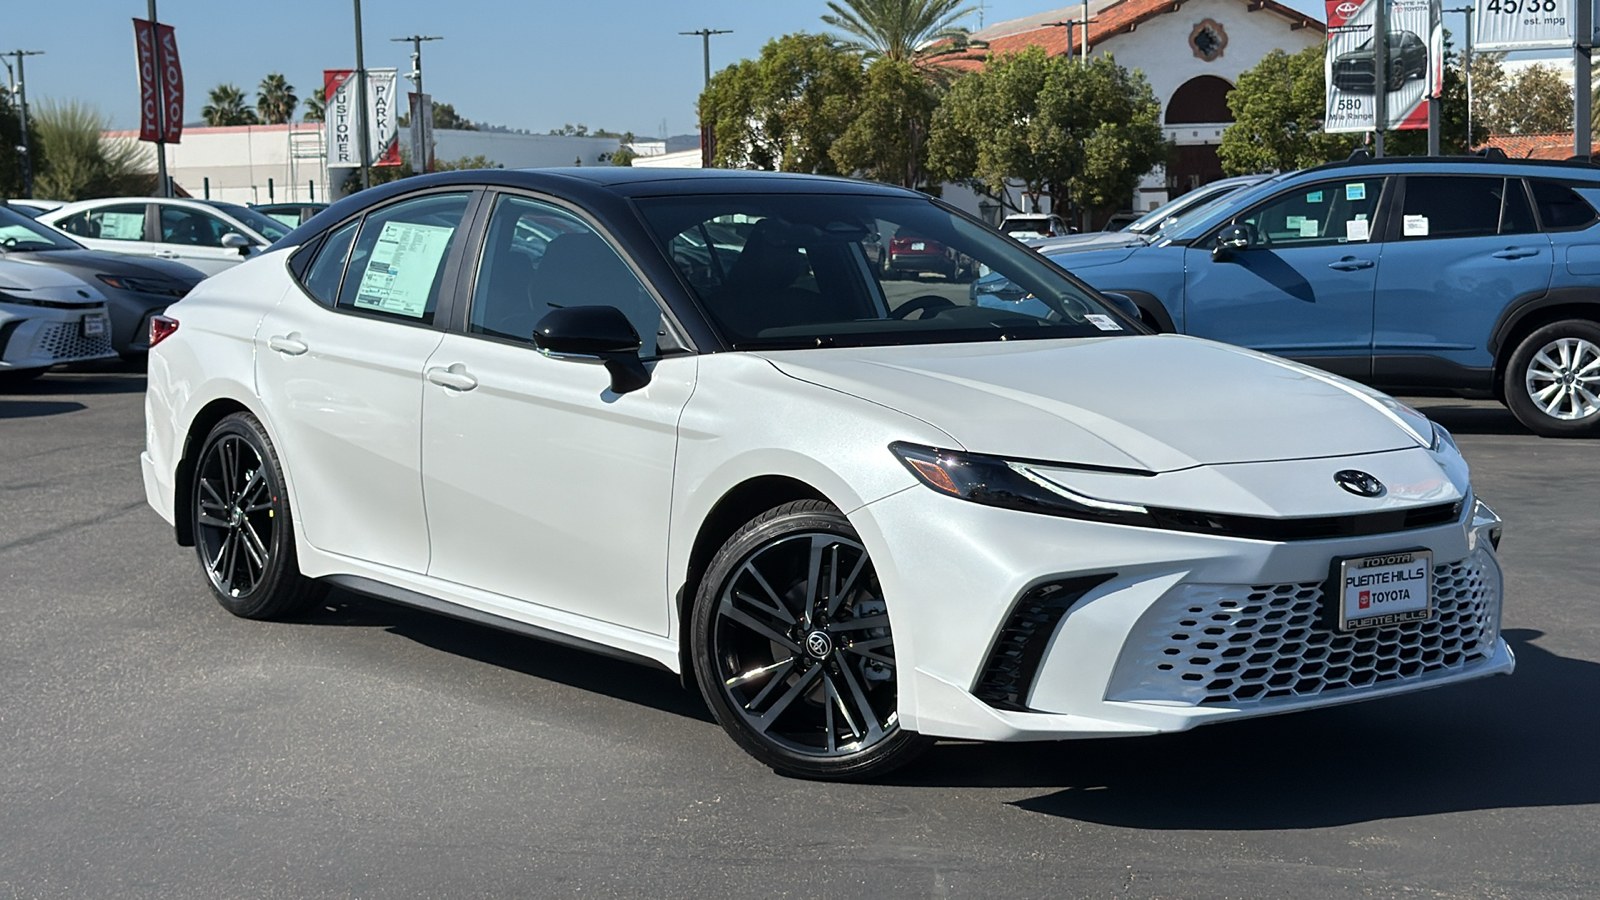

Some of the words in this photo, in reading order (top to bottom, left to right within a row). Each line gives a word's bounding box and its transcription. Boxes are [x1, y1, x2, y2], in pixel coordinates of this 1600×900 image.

[1487, 0, 1556, 14] 45/38
[1544, 17, 1565, 26] mpg
[140, 29, 155, 135] TOYOTA
[163, 33, 179, 137] TOYOTA
[1338, 99, 1361, 110] 580
[336, 85, 349, 162] CUSTOMER
[375, 86, 390, 160] PARKING
[1347, 113, 1373, 121] Range
[1366, 554, 1411, 567] TOYOTA
[1345, 572, 1390, 588] PUENTE
[1392, 568, 1424, 582] HILLS
[1372, 589, 1410, 603] TOYOTA
[1348, 615, 1393, 629] PUENTE
[1394, 610, 1427, 622] HILLS
